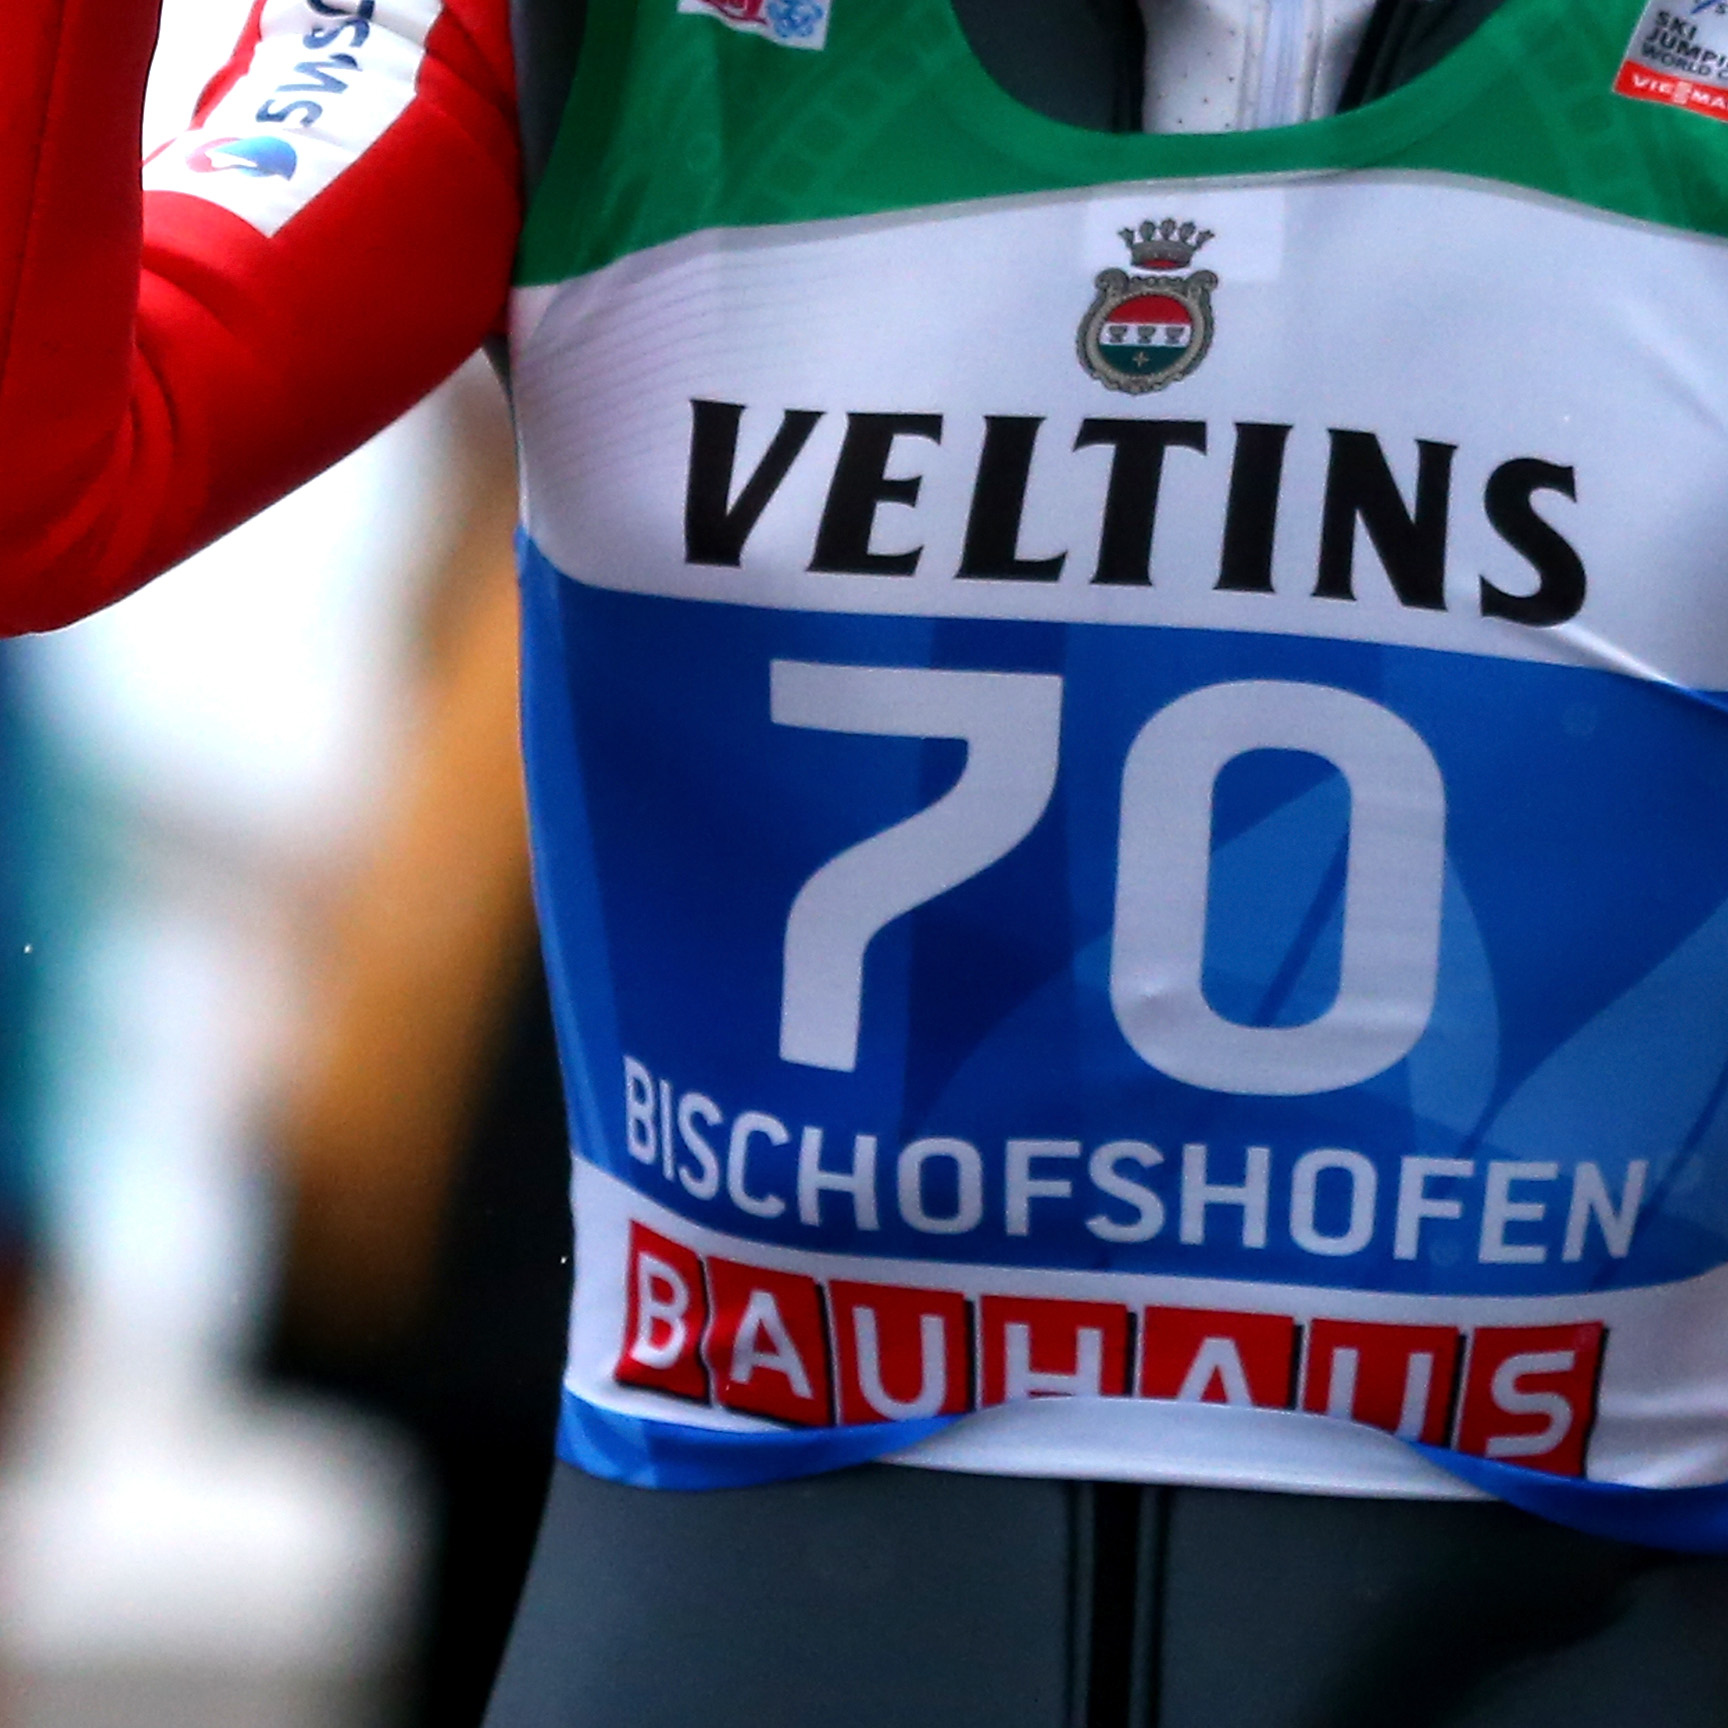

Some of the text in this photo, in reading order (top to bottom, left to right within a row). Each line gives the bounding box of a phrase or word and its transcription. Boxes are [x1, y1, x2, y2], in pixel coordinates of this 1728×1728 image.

[1640, 42, 1714, 78] WORLD
[1656, 9, 1698, 40] SKI
[682, 398, 1589, 629] VELTINS
[768, 658, 1447, 1095] 70
[620, 1053, 1653, 1265] BISCHOFSHOFEN
